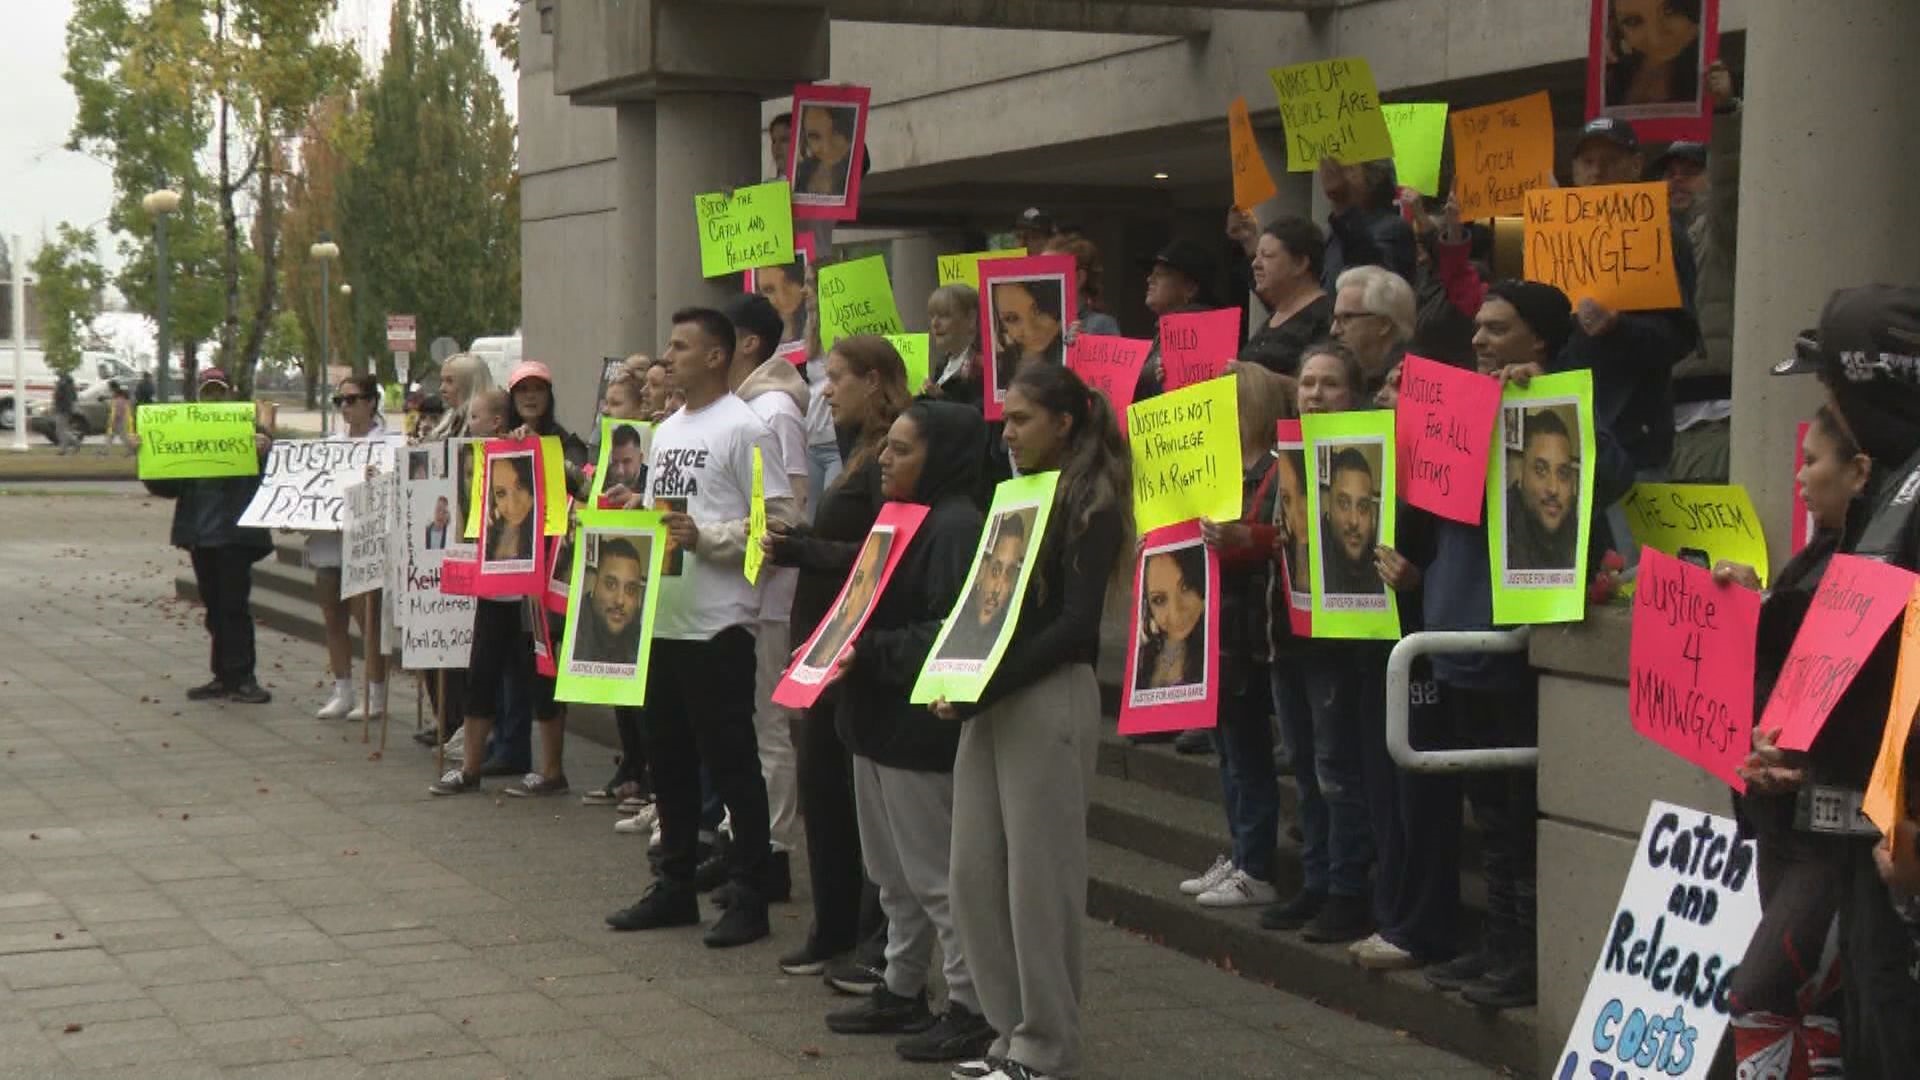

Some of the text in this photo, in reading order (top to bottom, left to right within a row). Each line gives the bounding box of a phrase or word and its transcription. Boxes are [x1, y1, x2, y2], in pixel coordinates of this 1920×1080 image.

[1338, 89, 1374, 119] ARE
[1475, 140, 1516, 175] CATCH
[737, 194, 752, 206] THE
[1527, 192, 1655, 230] WE DEMAND
[709, 216, 764, 242] CATCH AND
[726, 234, 779, 269] RELEASE!
[942, 261, 965, 280] WE
[830, 300, 876, 325] JUSTICE
[1163, 320, 1198, 353] FAILED
[1404, 360, 1443, 404] JUSTICE
[142, 408, 177, 424] STOP
[1131, 399, 1213, 436] JUSTICE IS NOT
[1145, 431, 1205, 460] A PRIVILEGE
[1425, 412, 1472, 455] FOR ALL
[656, 448, 709, 468] USTICE
[1408, 440, 1451, 496] VICTIMS
[653, 477, 697, 497] EISHA
[1159, 472, 1169, 495] A
[1625, 491, 1755, 540] THE SYSTEM
[1640, 557, 1719, 630] Justice
[405, 626, 430, 653] April
[450, 628, 473, 648] 202
[1682, 632, 1703, 687] 4
[1635, 668, 1737, 754] MMIWG2S+
[1648, 813, 1753, 892] Catch
